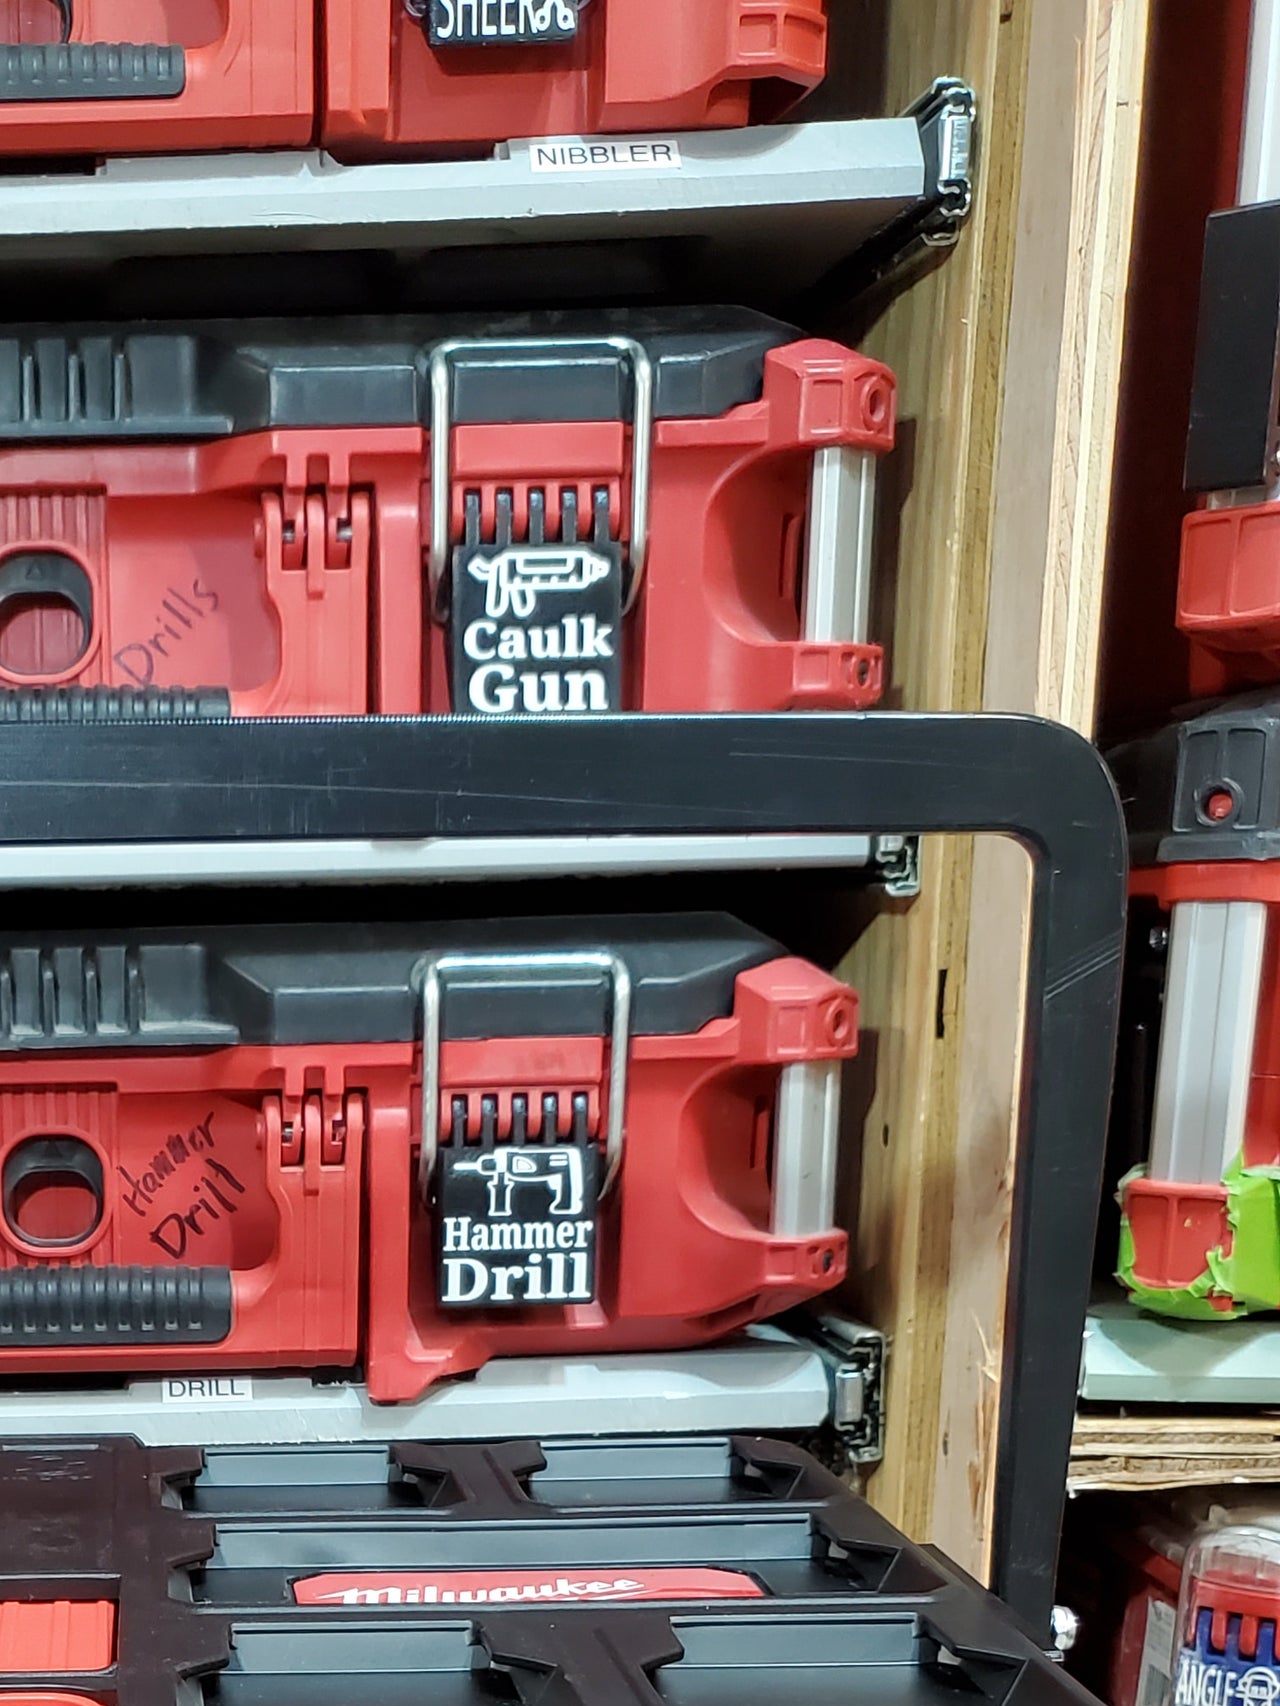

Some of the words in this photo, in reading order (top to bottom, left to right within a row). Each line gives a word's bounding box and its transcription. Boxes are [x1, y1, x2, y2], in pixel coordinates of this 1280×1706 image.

[536, 144, 672, 166] NIBBLER
[114, 578, 217, 687] Drills
[463, 614, 614, 661] Caulk
[468, 663, 609, 714] Gun
[118, 1111, 215, 1217] Hammer
[150, 1157, 246, 1260] Drill
[442, 1216, 594, 1252] Hammer
[441, 1251, 592, 1302] Drill
[167, 1378, 245, 1398] DRILL
[319, 1577, 646, 1604] Milwaukee
